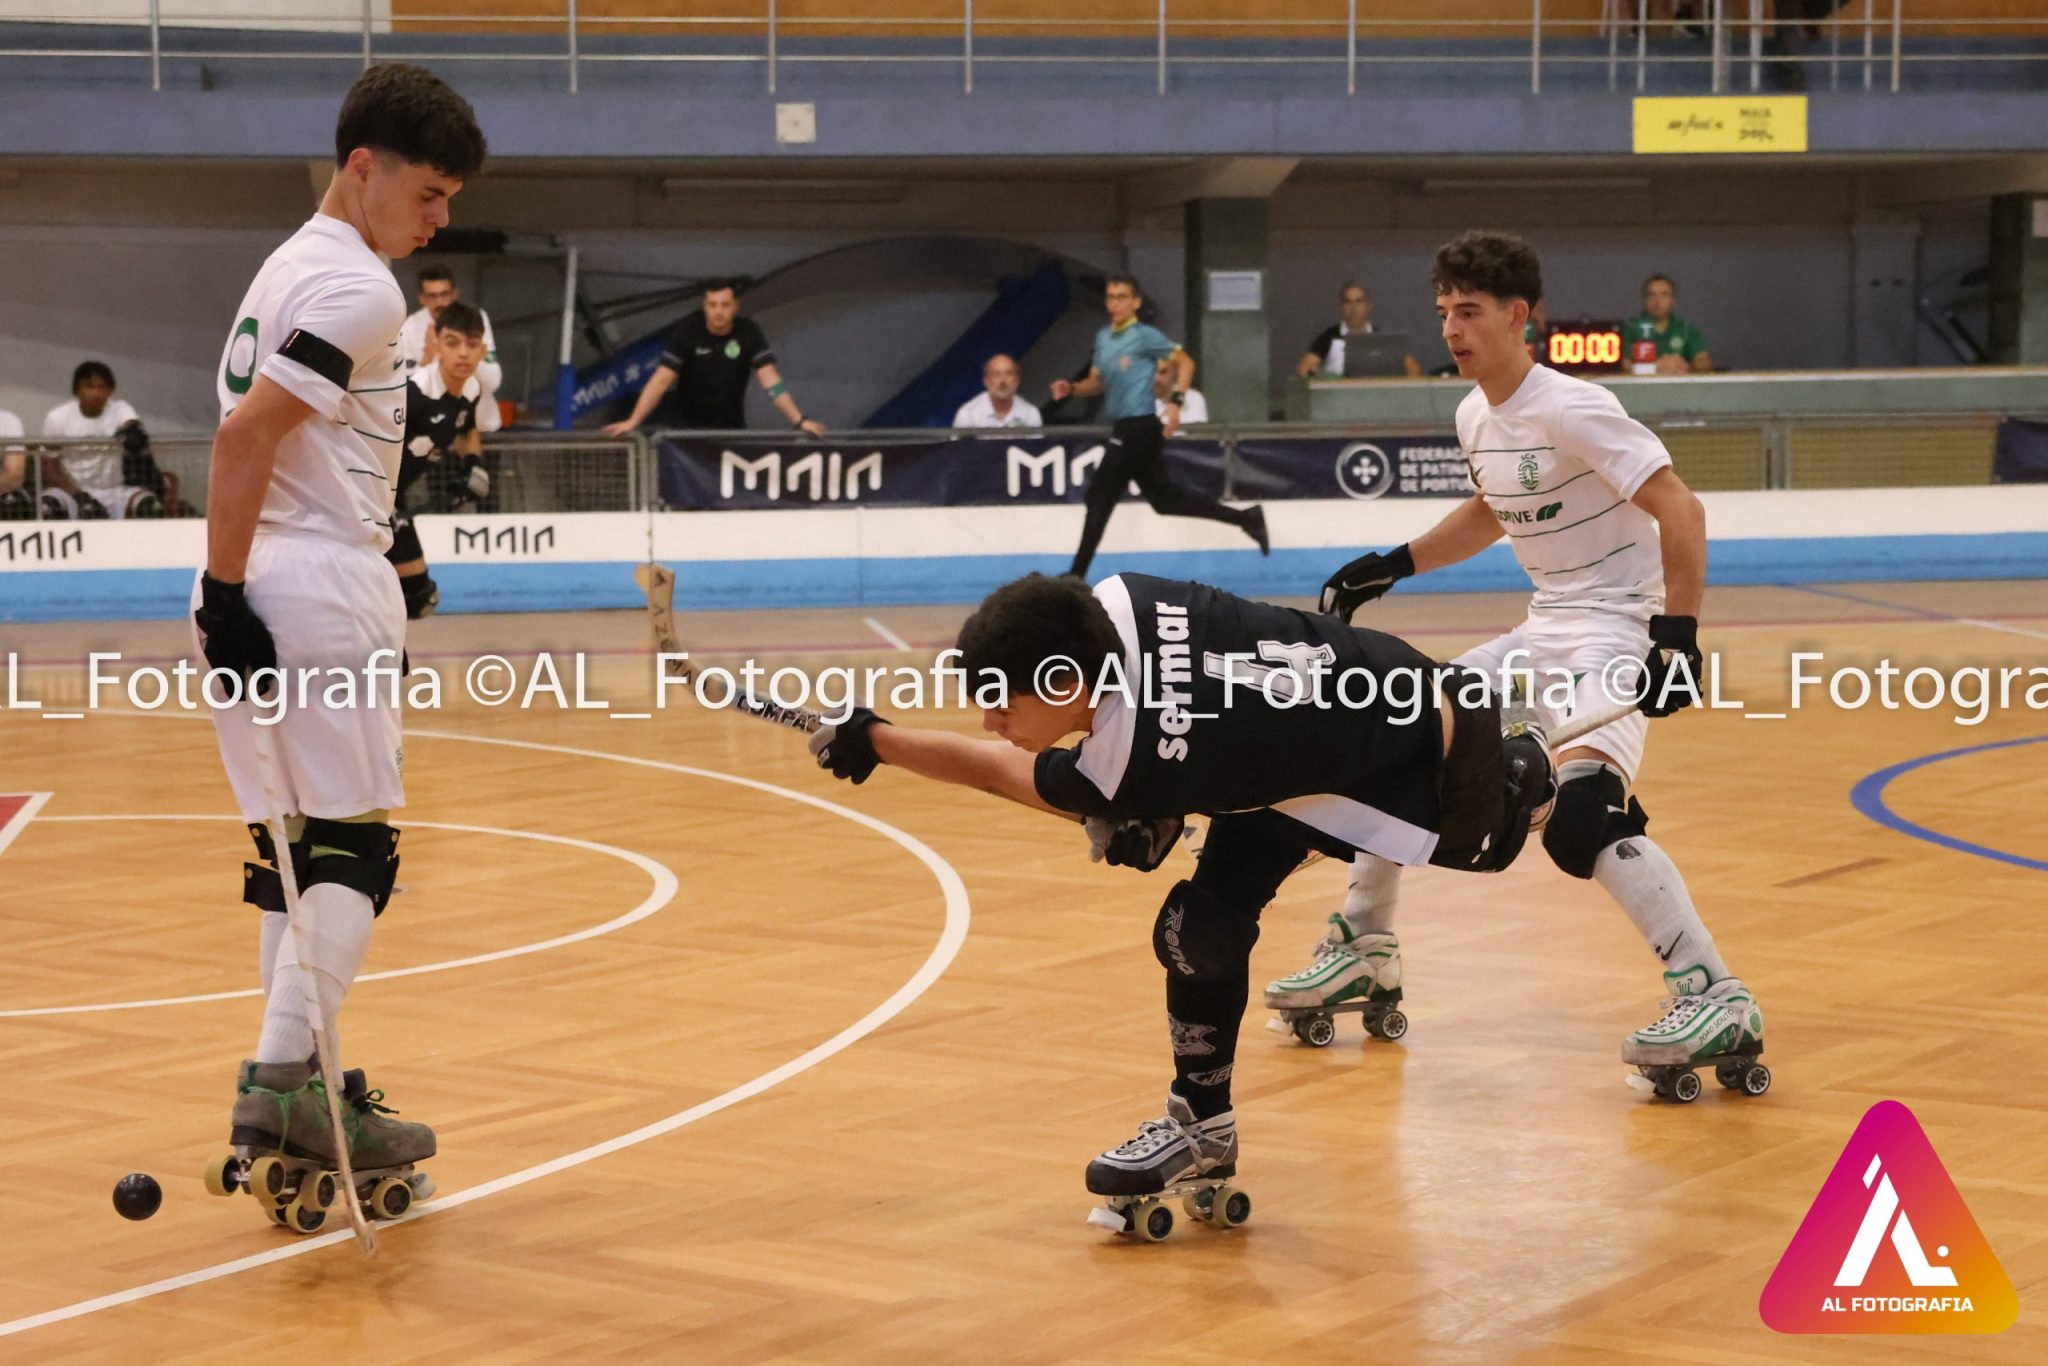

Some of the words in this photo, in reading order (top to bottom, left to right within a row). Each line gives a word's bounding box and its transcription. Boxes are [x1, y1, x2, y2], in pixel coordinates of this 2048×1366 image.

[1399, 463, 1418, 477] DE
[1420, 463, 1470, 477] PATINA
[1399, 480, 1418, 492] DE
[1155, 601, 1193, 762] sermar
